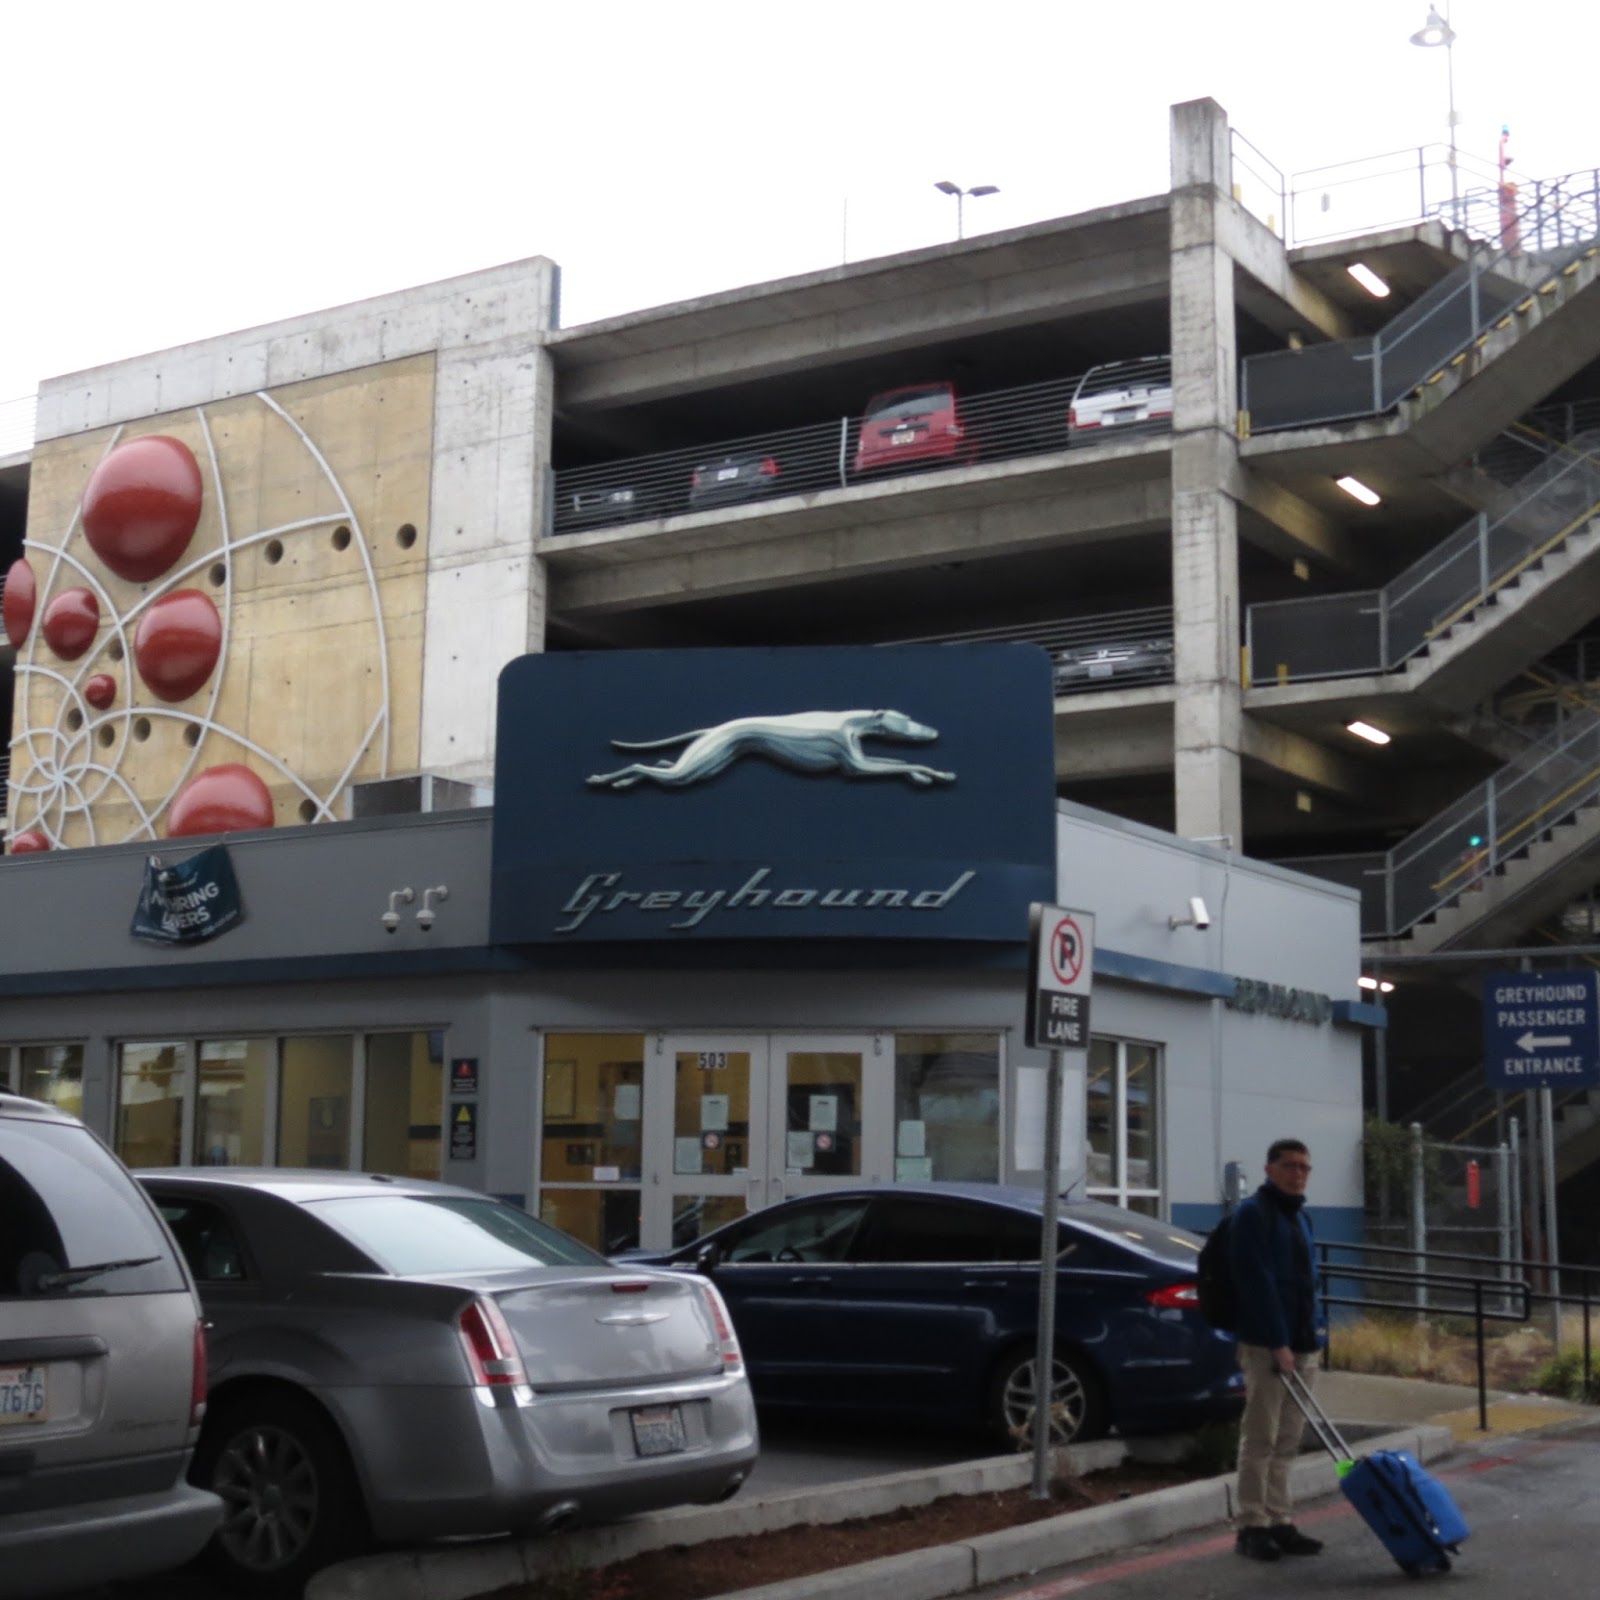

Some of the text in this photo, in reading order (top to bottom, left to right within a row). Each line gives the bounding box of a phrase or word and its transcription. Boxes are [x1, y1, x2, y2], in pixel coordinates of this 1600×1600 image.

[554, 867, 976, 932] Greyhound
[1495, 984, 1587, 1004] GREYHOUND
[1051, 995, 1079, 1018] FIRE
[1497, 1008, 1586, 1027] PASSENGER
[1047, 1020, 1081, 1042] LANE
[700, 1052, 726, 1068] 503
[1504, 1056, 1583, 1075] ENTRANCE
